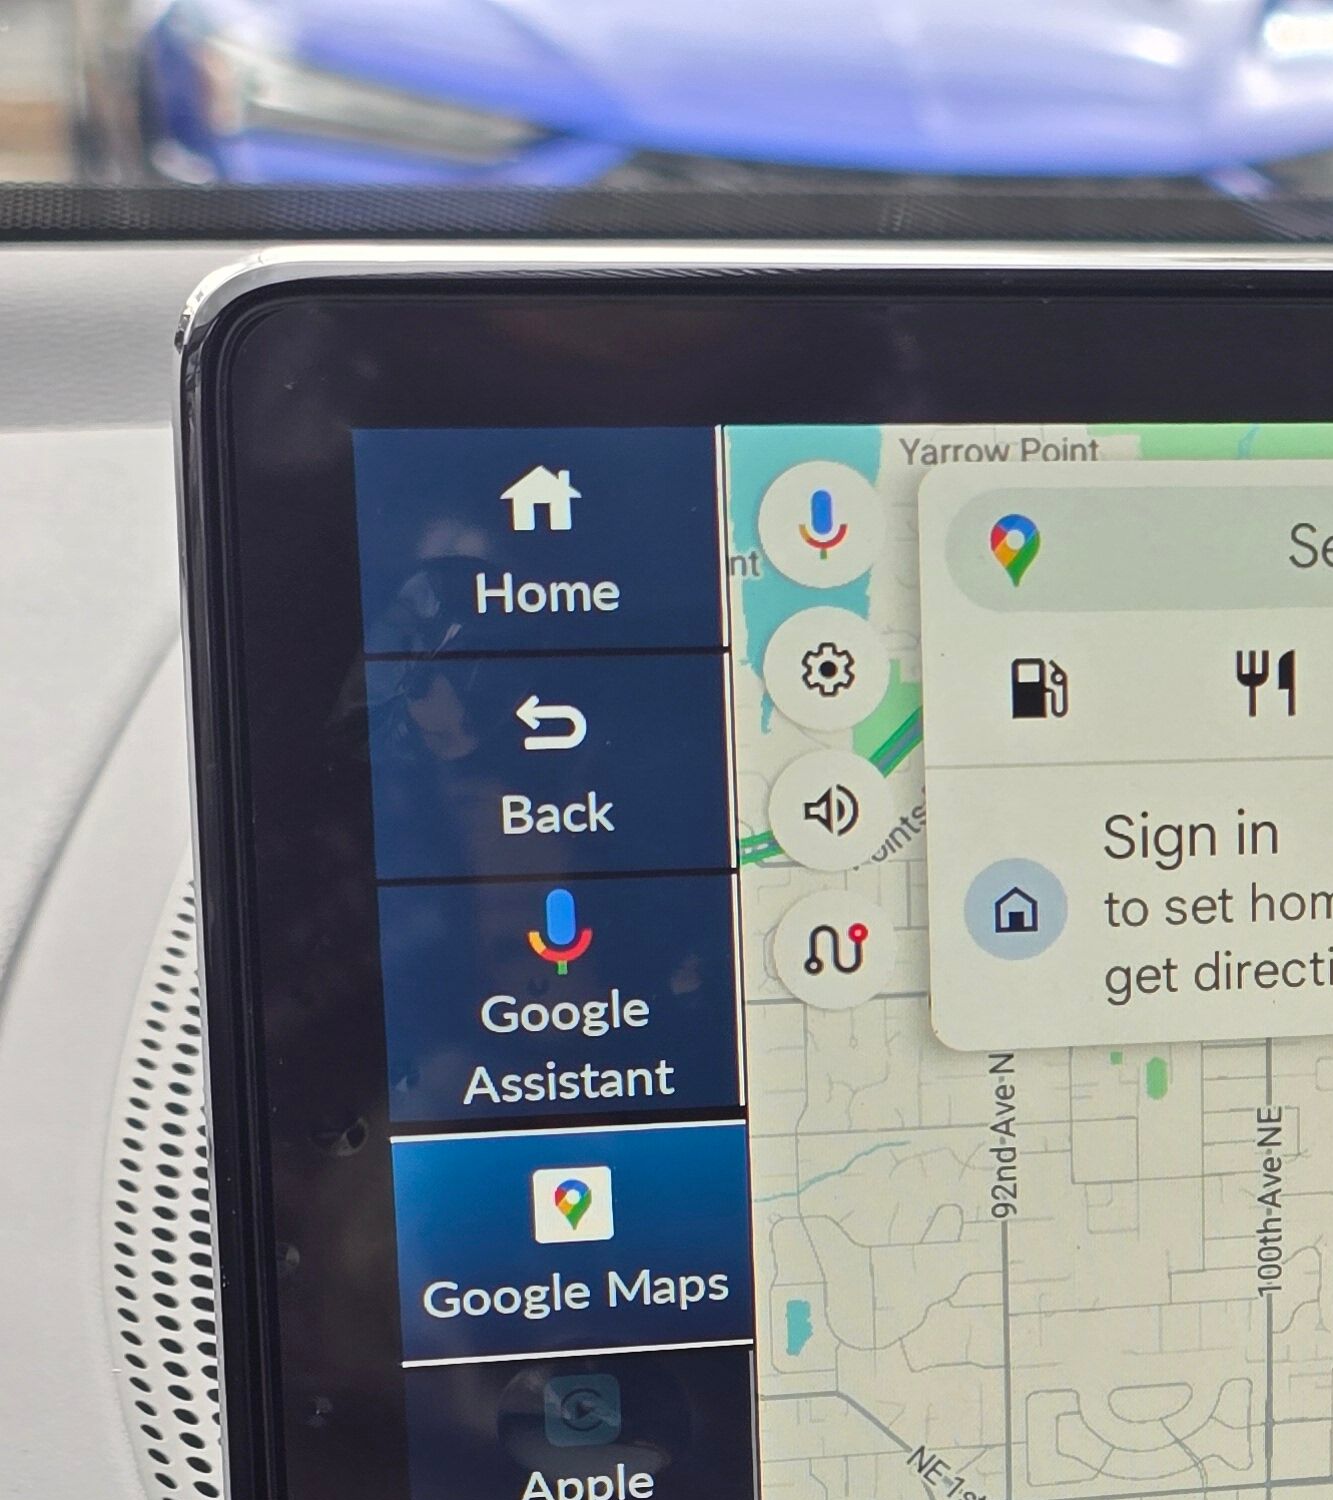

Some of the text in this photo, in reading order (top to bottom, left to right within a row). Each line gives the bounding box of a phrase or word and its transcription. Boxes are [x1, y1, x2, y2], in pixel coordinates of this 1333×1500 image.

[899, 437, 1099, 465] Yarrow Point
[475, 574, 620, 614] Home
[501, 792, 615, 834] Back
[1103, 809, 1279, 870] Sign in
[1104, 888, 1150, 927] to
[1164, 886, 1234, 925] set
[1105, 956, 1178, 1006] get
[481, 991, 650, 1038] Google
[463, 1059, 675, 1105] Assistant
[989, 1053, 1017, 1218] 92nd Ave N
[1256, 1106, 1282, 1297] 100th Ave NE
[423, 1268, 730, 1320] Google Maps
[907, 1445, 951, 1486] NE
